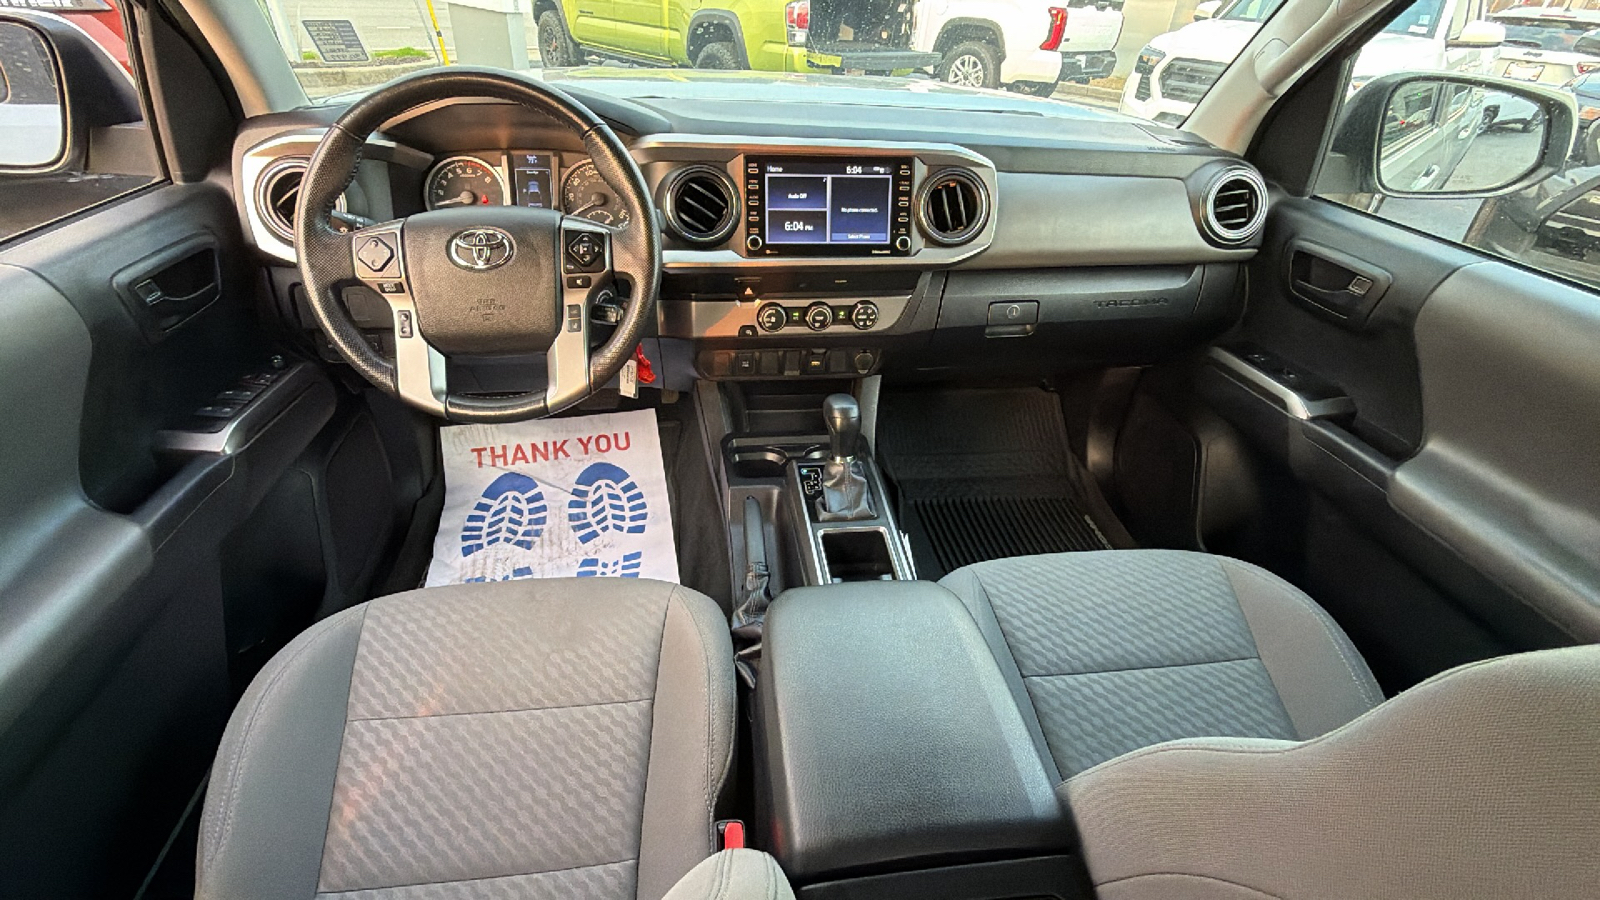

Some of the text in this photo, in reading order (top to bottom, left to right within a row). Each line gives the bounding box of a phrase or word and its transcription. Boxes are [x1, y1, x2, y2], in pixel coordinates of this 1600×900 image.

[766, 165, 784, 173] Home
[846, 166, 863, 174] 6:04
[784, 221, 804, 231] 6:04
[471, 431, 631, 468] THANK YOU
